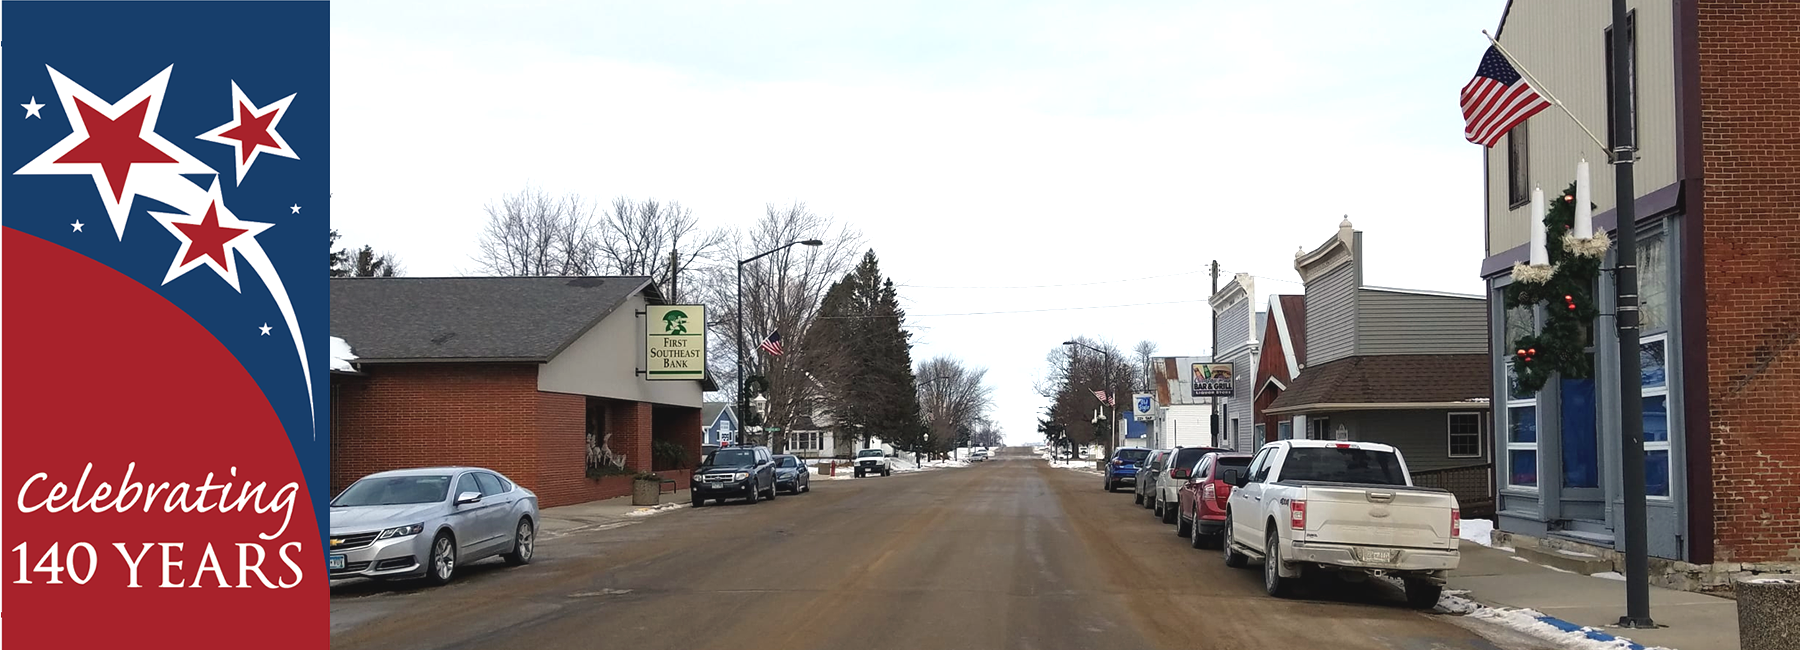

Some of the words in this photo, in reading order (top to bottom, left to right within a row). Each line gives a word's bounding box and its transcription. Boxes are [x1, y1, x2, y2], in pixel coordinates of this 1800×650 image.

[663, 337, 687, 347] FIRST
[650, 347, 700, 358] SOUTHEAST
[663, 358, 688, 368] BANK
[1213, 382, 1232, 390] GRILL
